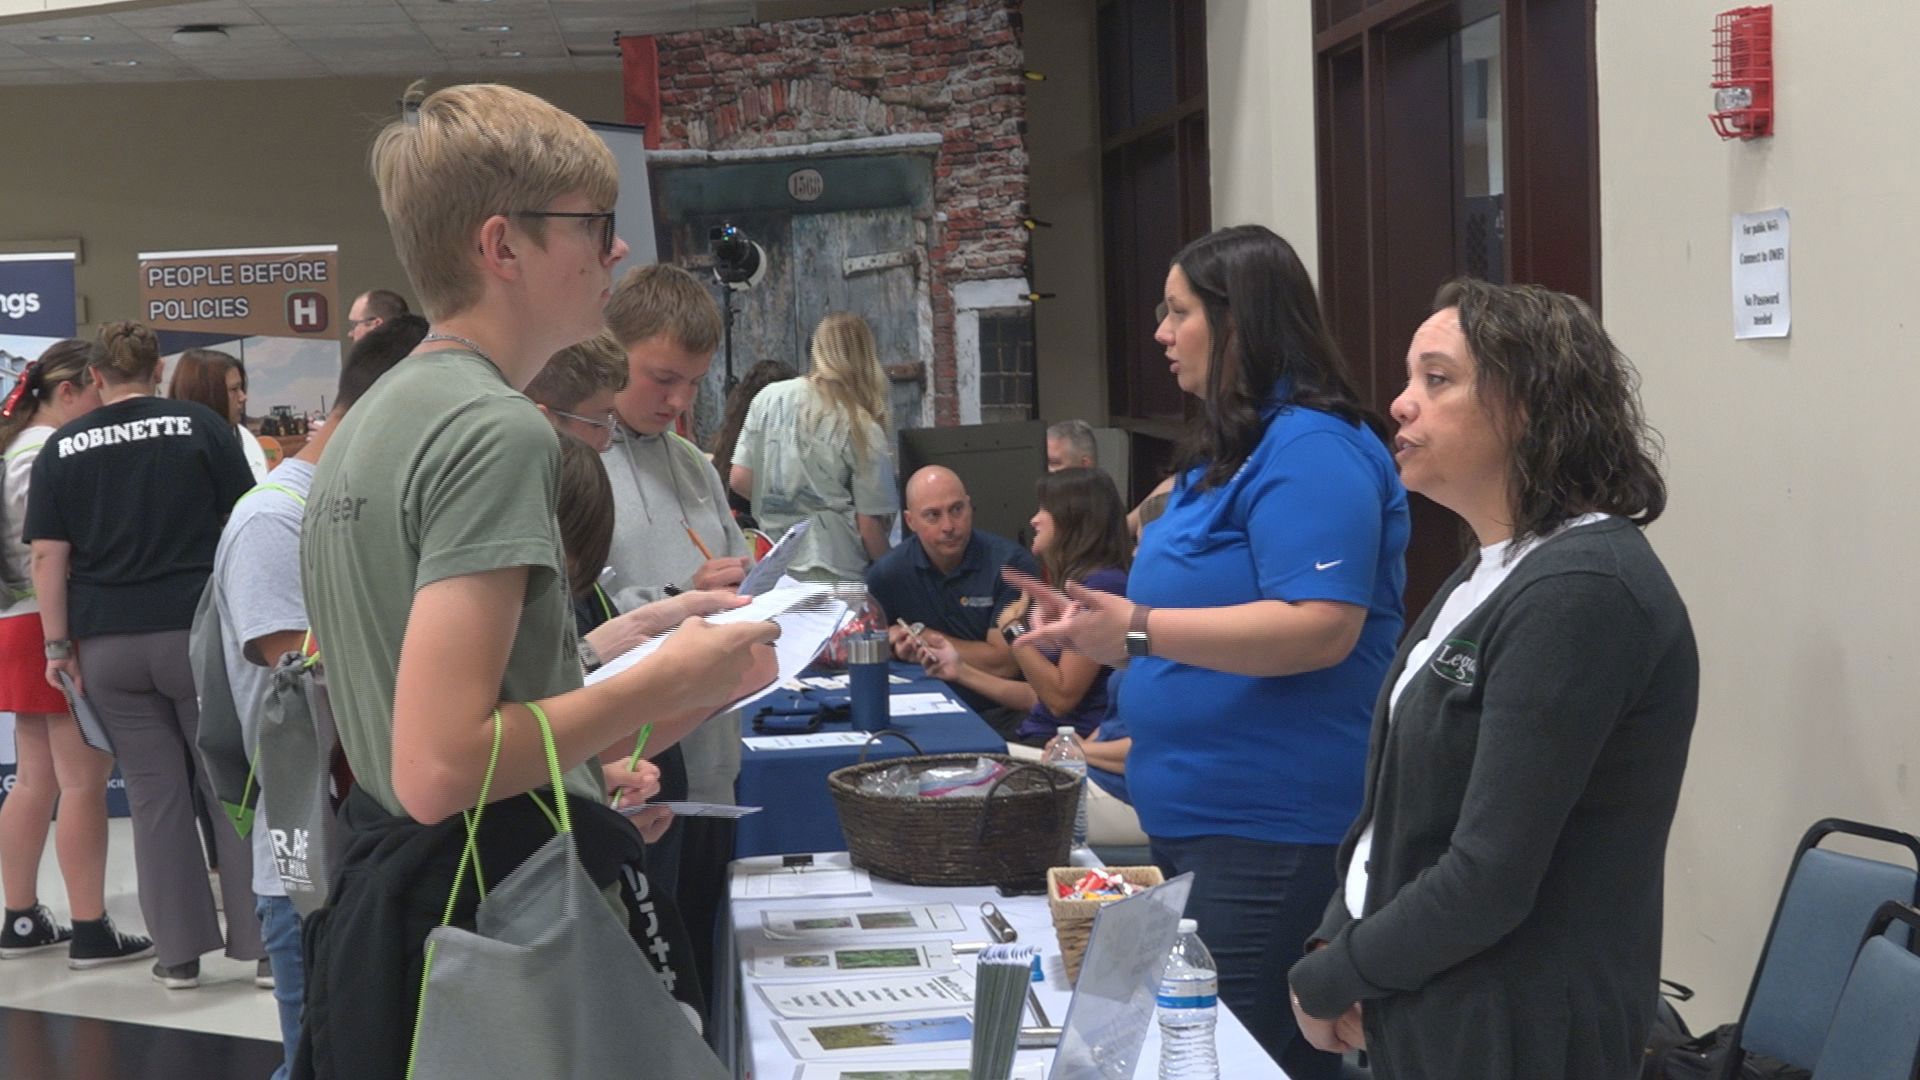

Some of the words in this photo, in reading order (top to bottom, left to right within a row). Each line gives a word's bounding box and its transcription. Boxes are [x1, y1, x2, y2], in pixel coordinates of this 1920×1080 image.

[149, 265, 234, 287] PEOPLE
[240, 262, 328, 284] BEFORE
[149, 298, 249, 320] POLICIES
[293, 298, 318, 325] H
[58, 416, 192, 458] ROBINETTE
